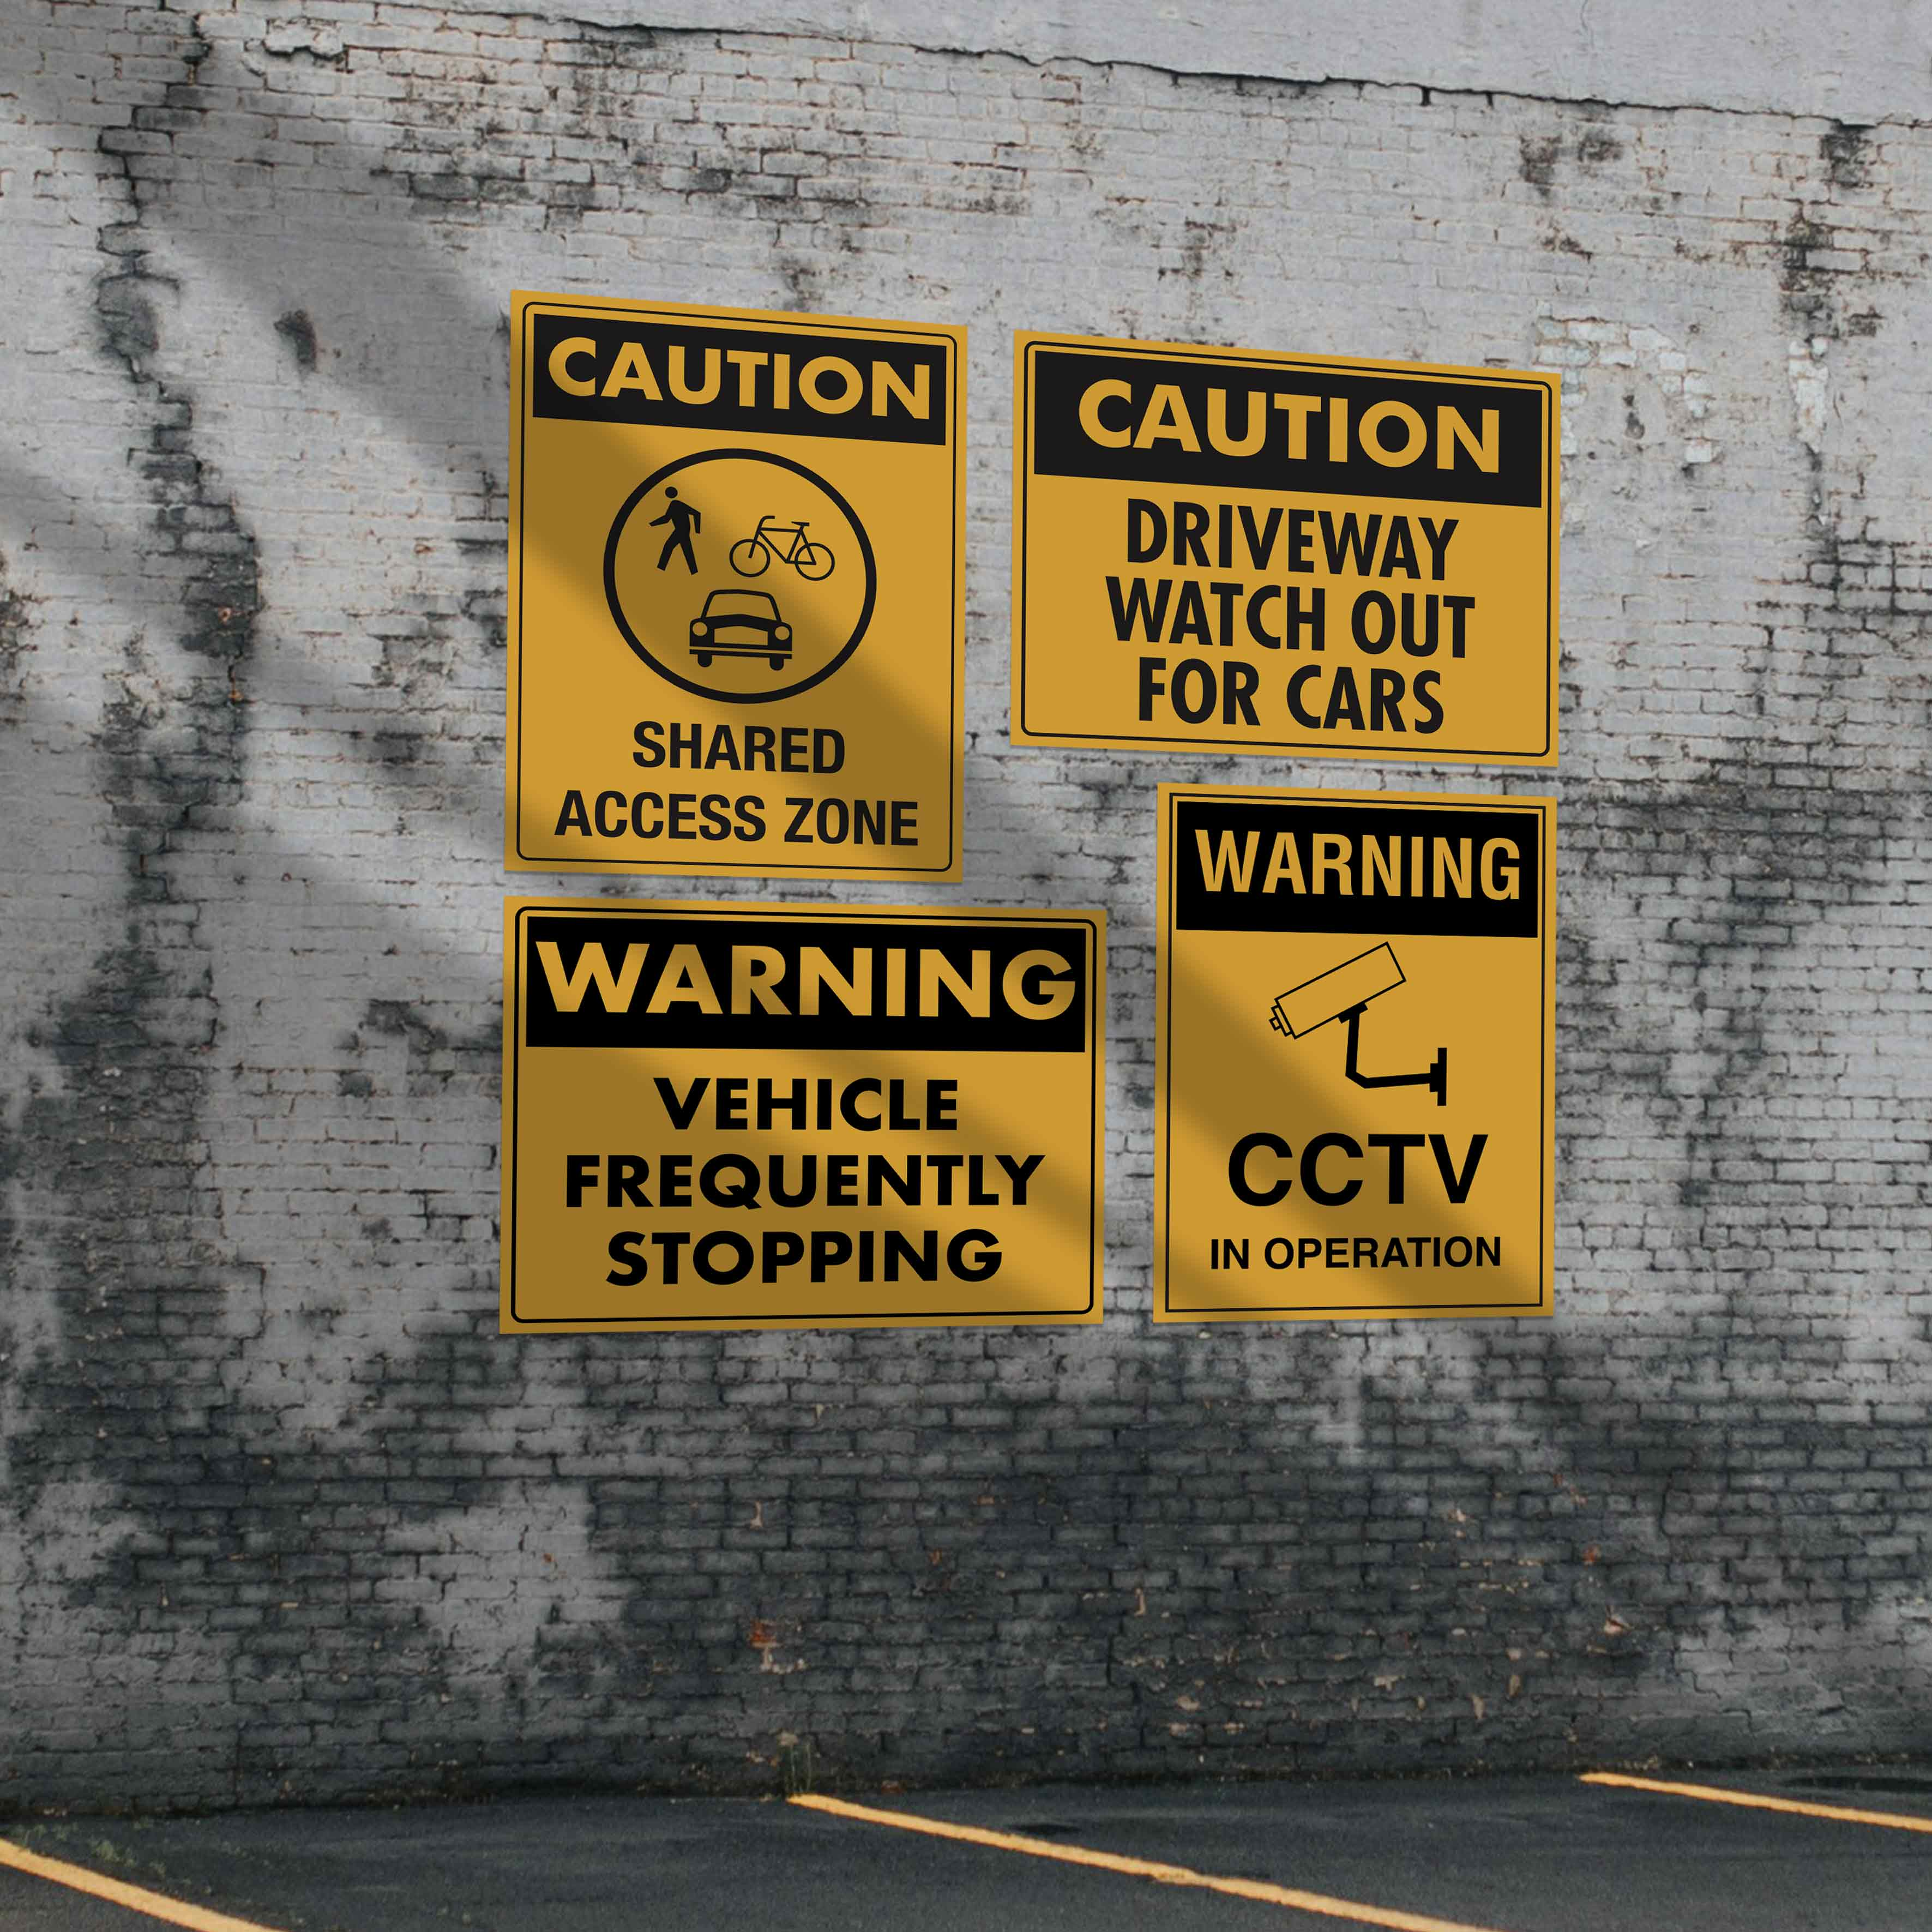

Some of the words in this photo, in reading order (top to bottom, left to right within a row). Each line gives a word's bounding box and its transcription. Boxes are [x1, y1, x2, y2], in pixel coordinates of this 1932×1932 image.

[549, 337, 930, 419] CAUTION
[1079, 379, 1499, 473] CAUTION
[1128, 498, 1459, 580] DRIVEWAY
[1106, 576, 1325, 651] WATCH
[1352, 591, 1474, 658] OUT
[1140, 657, 1260, 725] FOR
[1287, 665, 1443, 733] CARS
[633, 721, 845, 773] SHARED
[555, 790, 766, 841] ACCESS
[785, 798, 918, 846] ZONE
[1195, 829, 1519, 900] WARNING
[535, 942, 1075, 1020] WARNING
[654, 1078, 957, 1131] VEHICLE
[567, 1154, 1045, 1209] FREQUENTLY
[1229, 1133, 1488, 1206] CCTV
[606, 1229, 1002, 1286] STOPPING
[1212, 1239, 1248, 1269] IN
[1265, 1236, 1500, 1269] OPERATION
